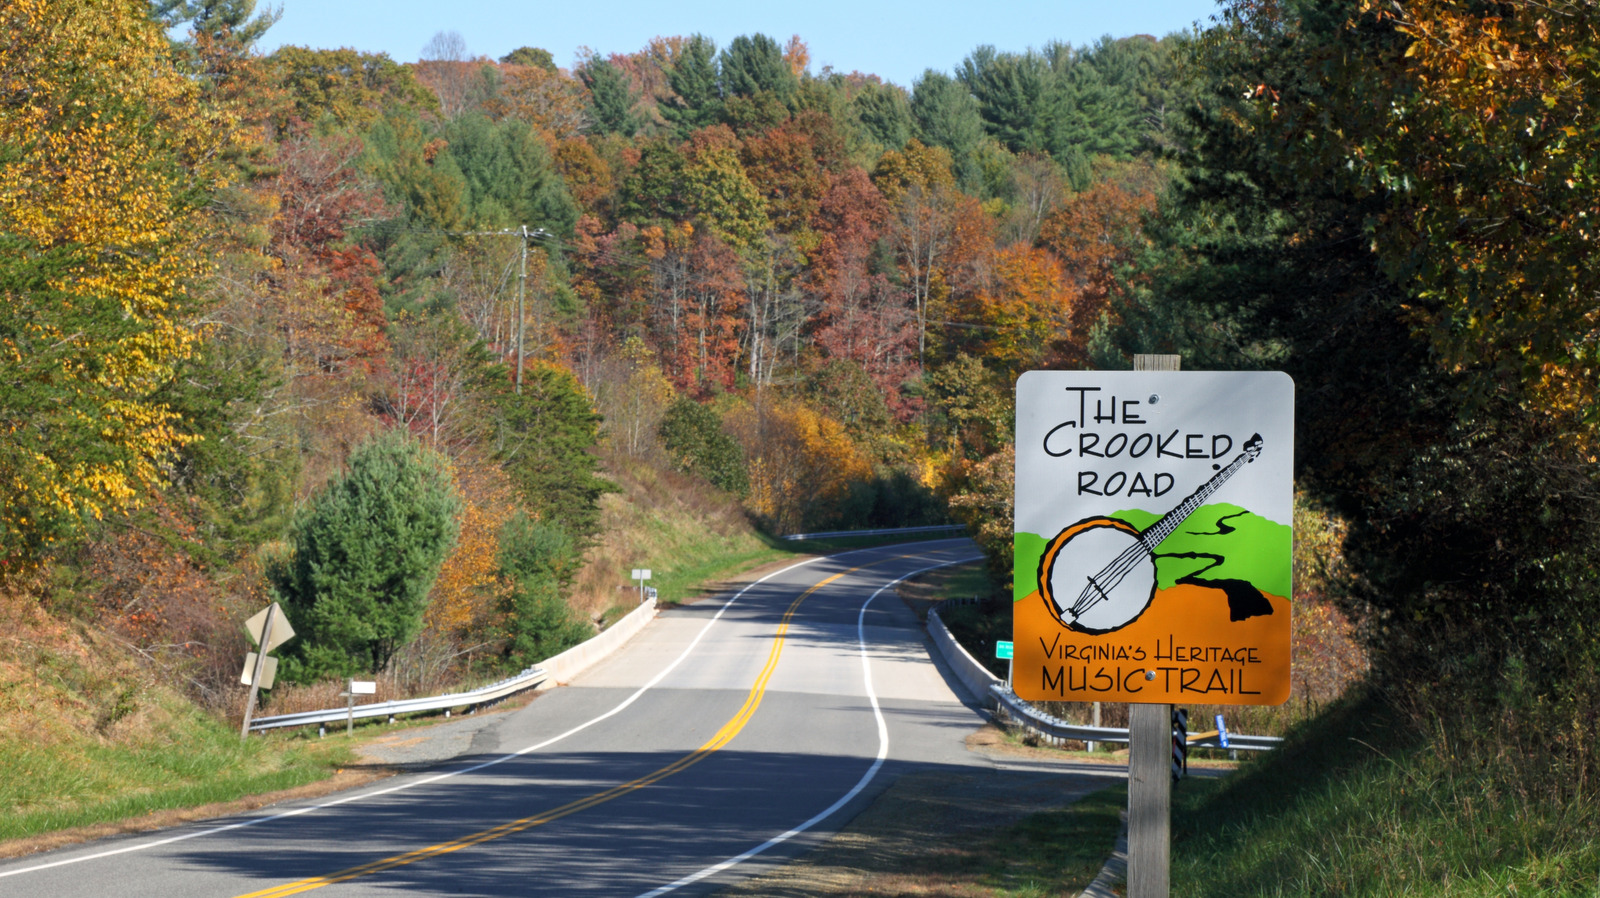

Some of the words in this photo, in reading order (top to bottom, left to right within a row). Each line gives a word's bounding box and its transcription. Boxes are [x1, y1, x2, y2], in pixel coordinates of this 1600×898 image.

[1066, 387, 1146, 428] THE
[1043, 421, 1232, 459] CROOKED
[1078, 471, 1175, 497] ROAD
[1039, 632, 1147, 664] VIRGINIA'S
[1154, 634, 1262, 666] HERITAGE
[1042, 665, 1146, 697] MUSIC
[1156, 667, 1262, 695] TRAIL
